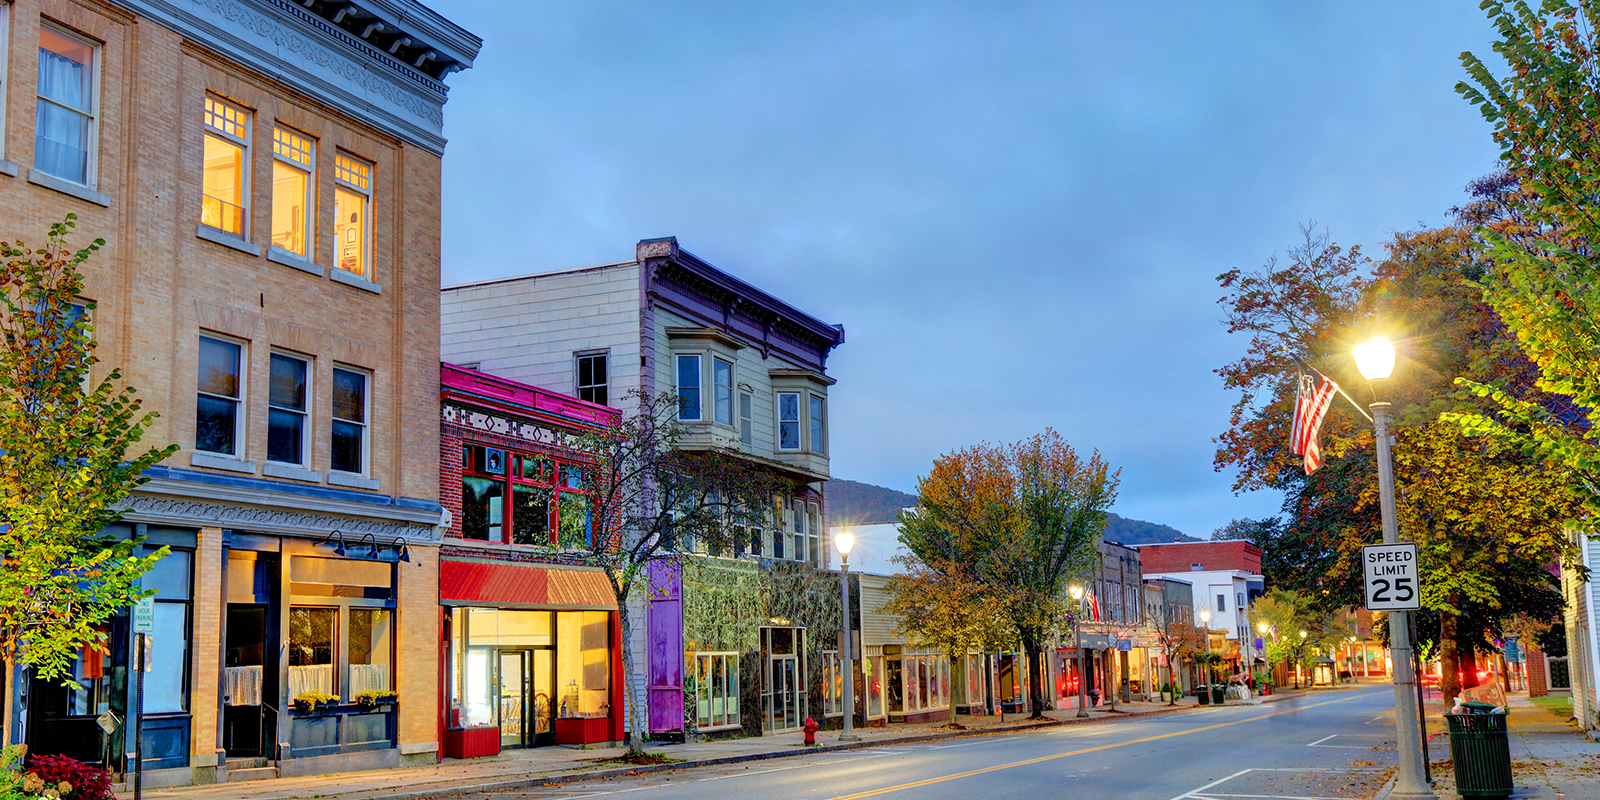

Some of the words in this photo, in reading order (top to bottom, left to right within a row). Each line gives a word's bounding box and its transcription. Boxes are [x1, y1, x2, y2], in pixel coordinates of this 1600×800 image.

[1368, 551, 1412, 563] SPEED
[1373, 564, 1407, 576] LIMIT
[1371, 577, 1414, 602] 25
